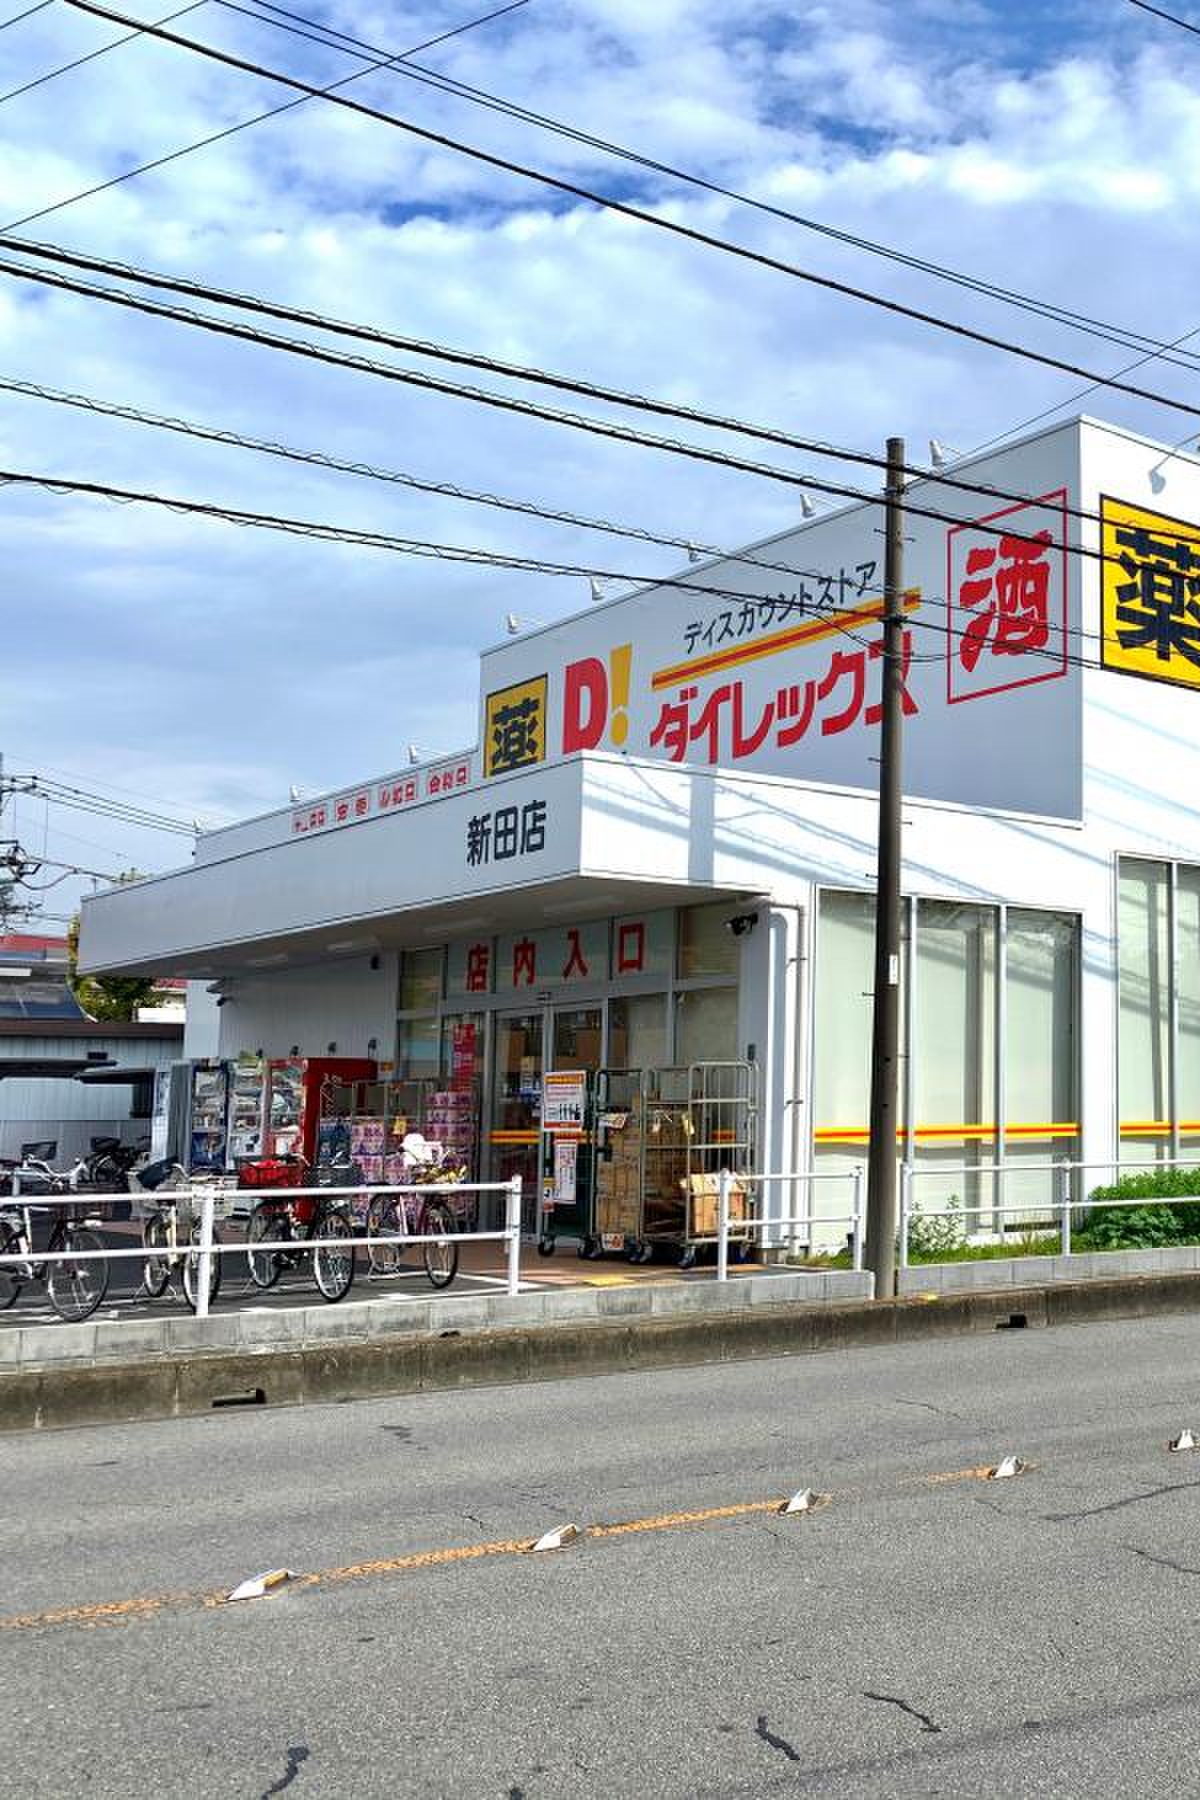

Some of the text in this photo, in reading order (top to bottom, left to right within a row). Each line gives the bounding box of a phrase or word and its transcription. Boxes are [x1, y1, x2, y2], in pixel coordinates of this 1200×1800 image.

[682, 560, 877, 655] ディスカウントストア
[959, 529, 1053, 673] 酒
[649, 632, 918, 764] ダイレックス
[466, 799, 547, 868] 新田店
[466, 922, 645, 993] 店内入口
